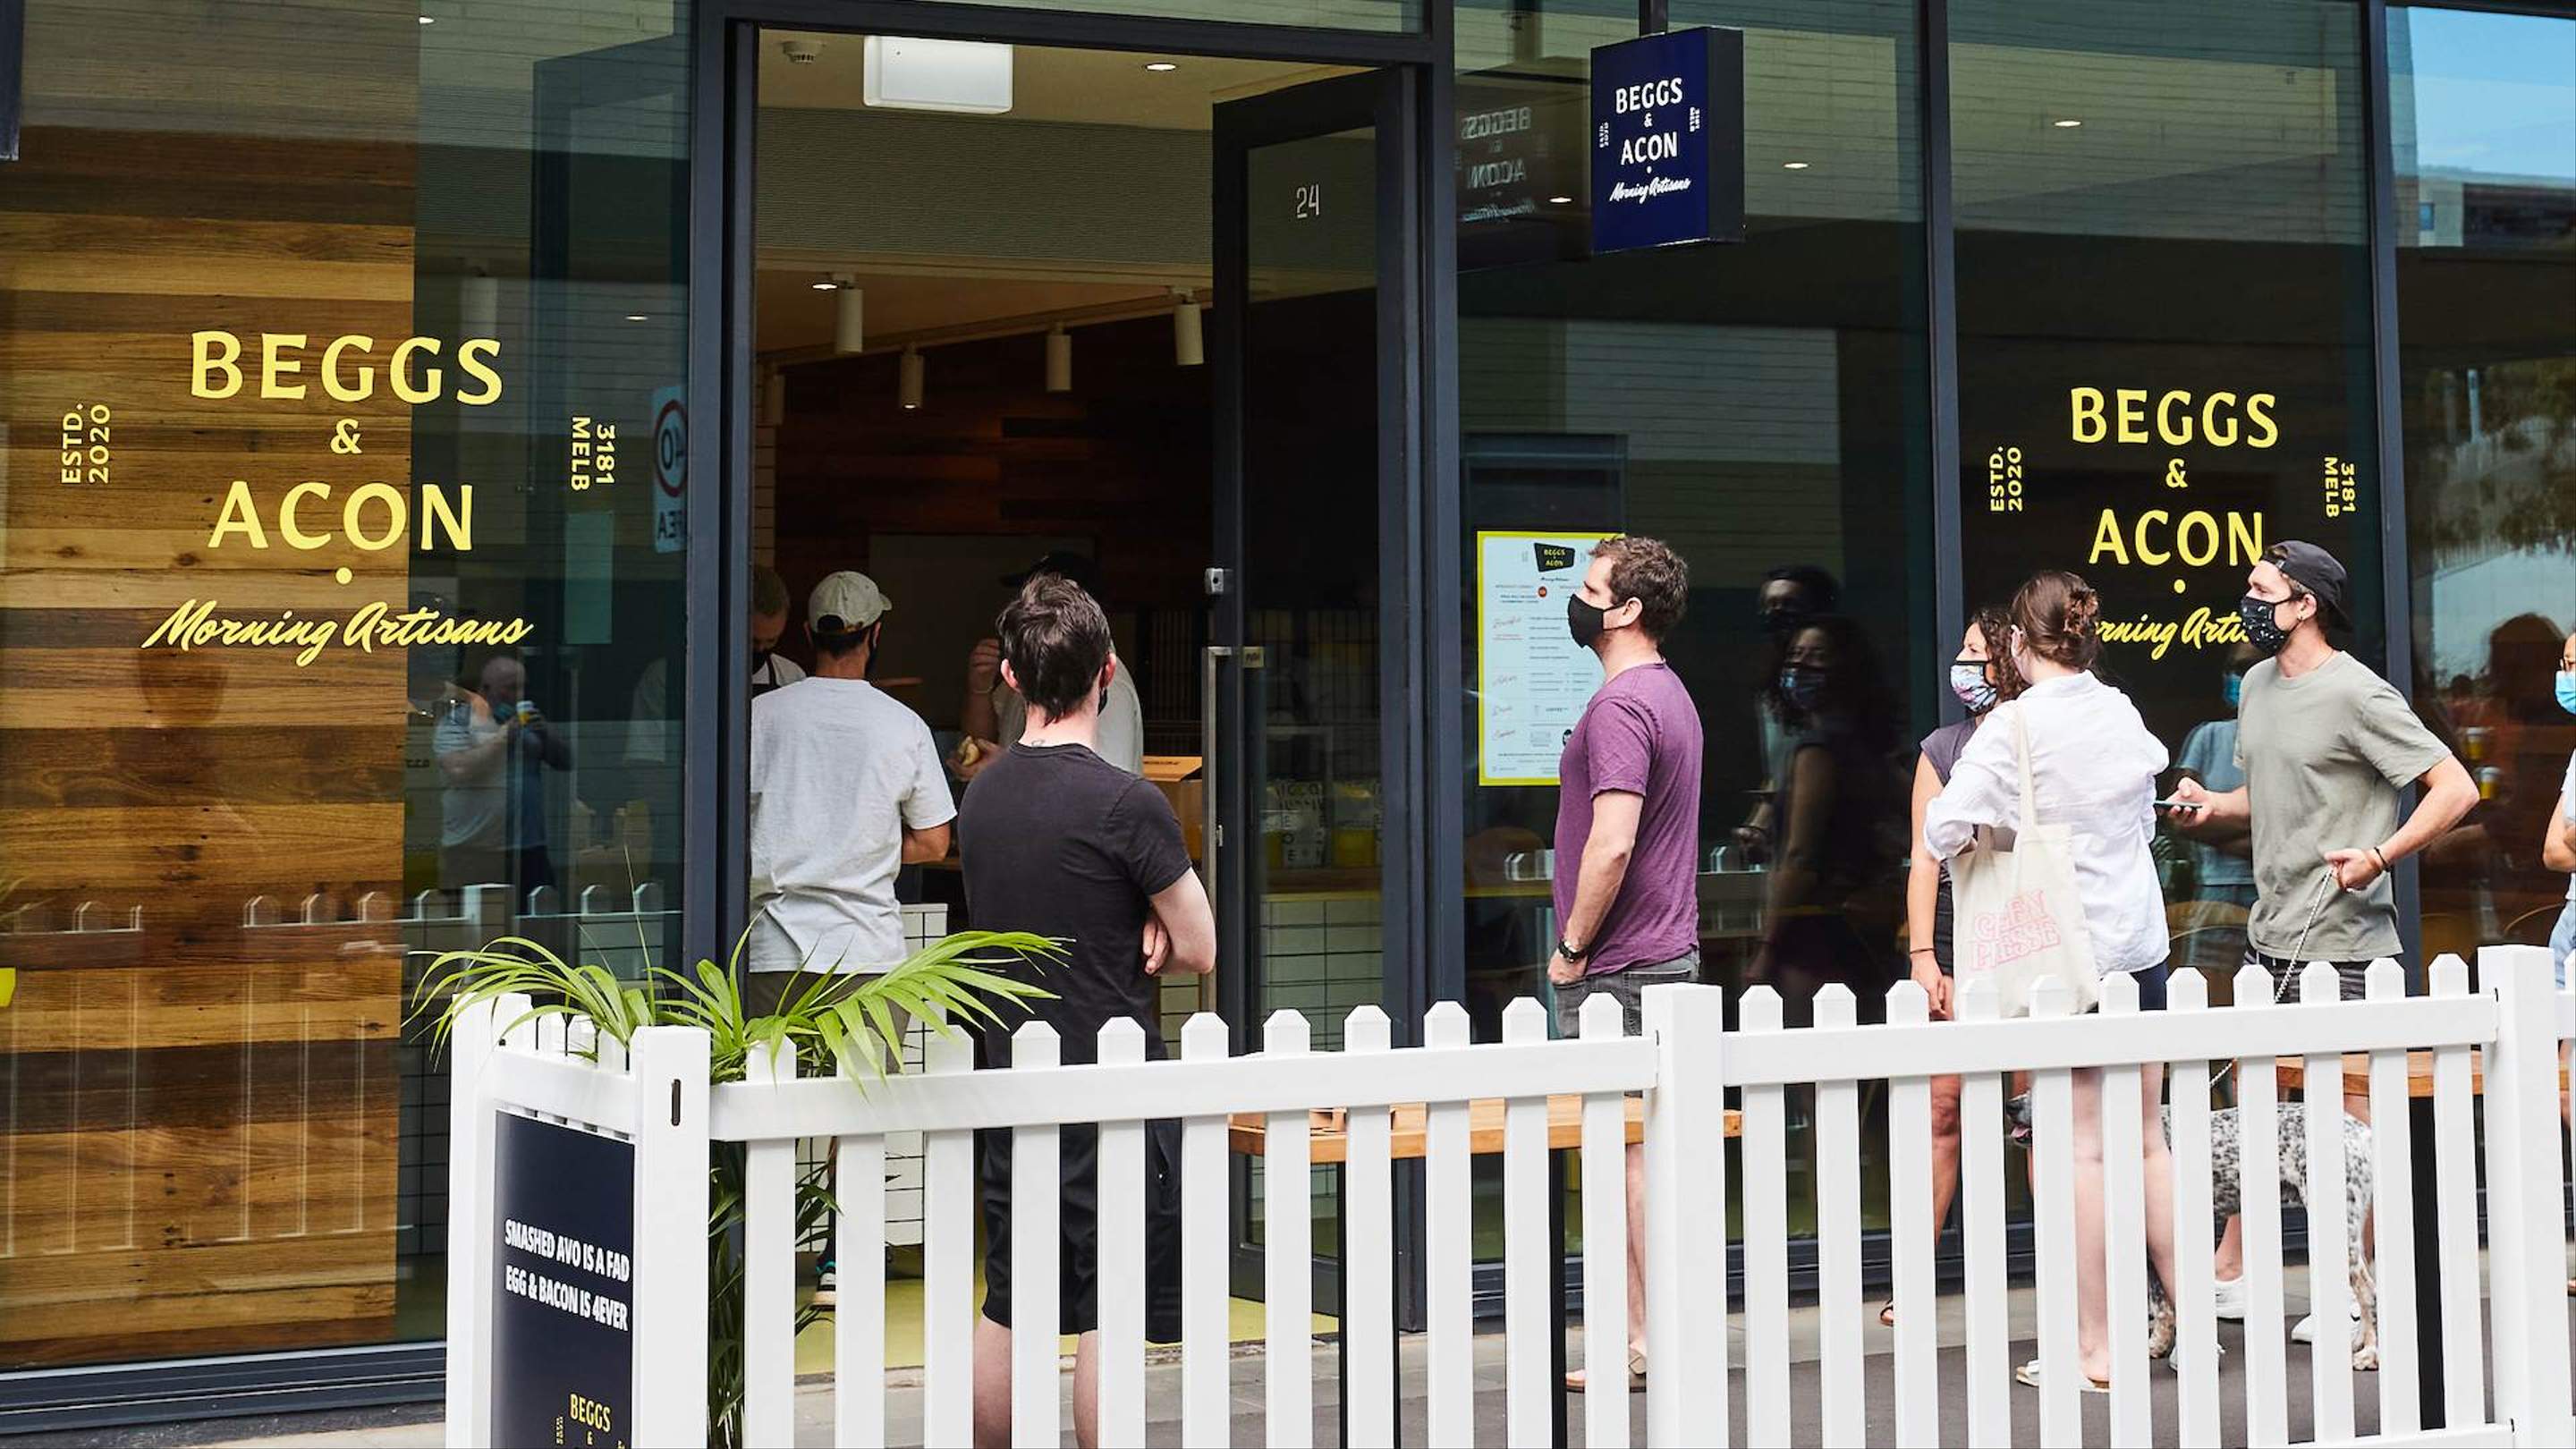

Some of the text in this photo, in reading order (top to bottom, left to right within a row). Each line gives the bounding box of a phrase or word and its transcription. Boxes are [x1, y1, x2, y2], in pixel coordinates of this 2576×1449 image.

[1615, 77, 1683, 114] BEGGS
[1643, 112, 1653, 128] &
[1621, 131, 1678, 165] ACON
[1297, 184, 1319, 218] 24
[1609, 176, 1691, 204] Morning Artisans
[190, 330, 503, 405] BEGGS
[61, 402, 83, 484] ESTD.
[89, 404, 111, 484] 2020
[330, 418, 362, 454] &
[2071, 387, 2279, 447] BEGGS
[571, 417, 590, 491] MELB
[596, 424, 615, 486] 3181
[1989, 445, 2005, 512] ESTD.
[2007, 447, 2023, 512] 2020
[2165, 458, 2189, 488] &
[207, 480, 472, 551] ACON
[2325, 456, 2340, 518] MELB
[2341, 463, 2356, 513] 3181
[2089, 508, 2264, 567] ACON
[140, 598, 534, 667] Morning Artisans
[2096, 606, 2250, 660] rning Arti
[504, 1218, 631, 1283] SMASHED AVO IS A FAD
[505, 1264, 629, 1332] EGG & BACON IS 4EVER
[570, 1394, 611, 1433] BEGGS
